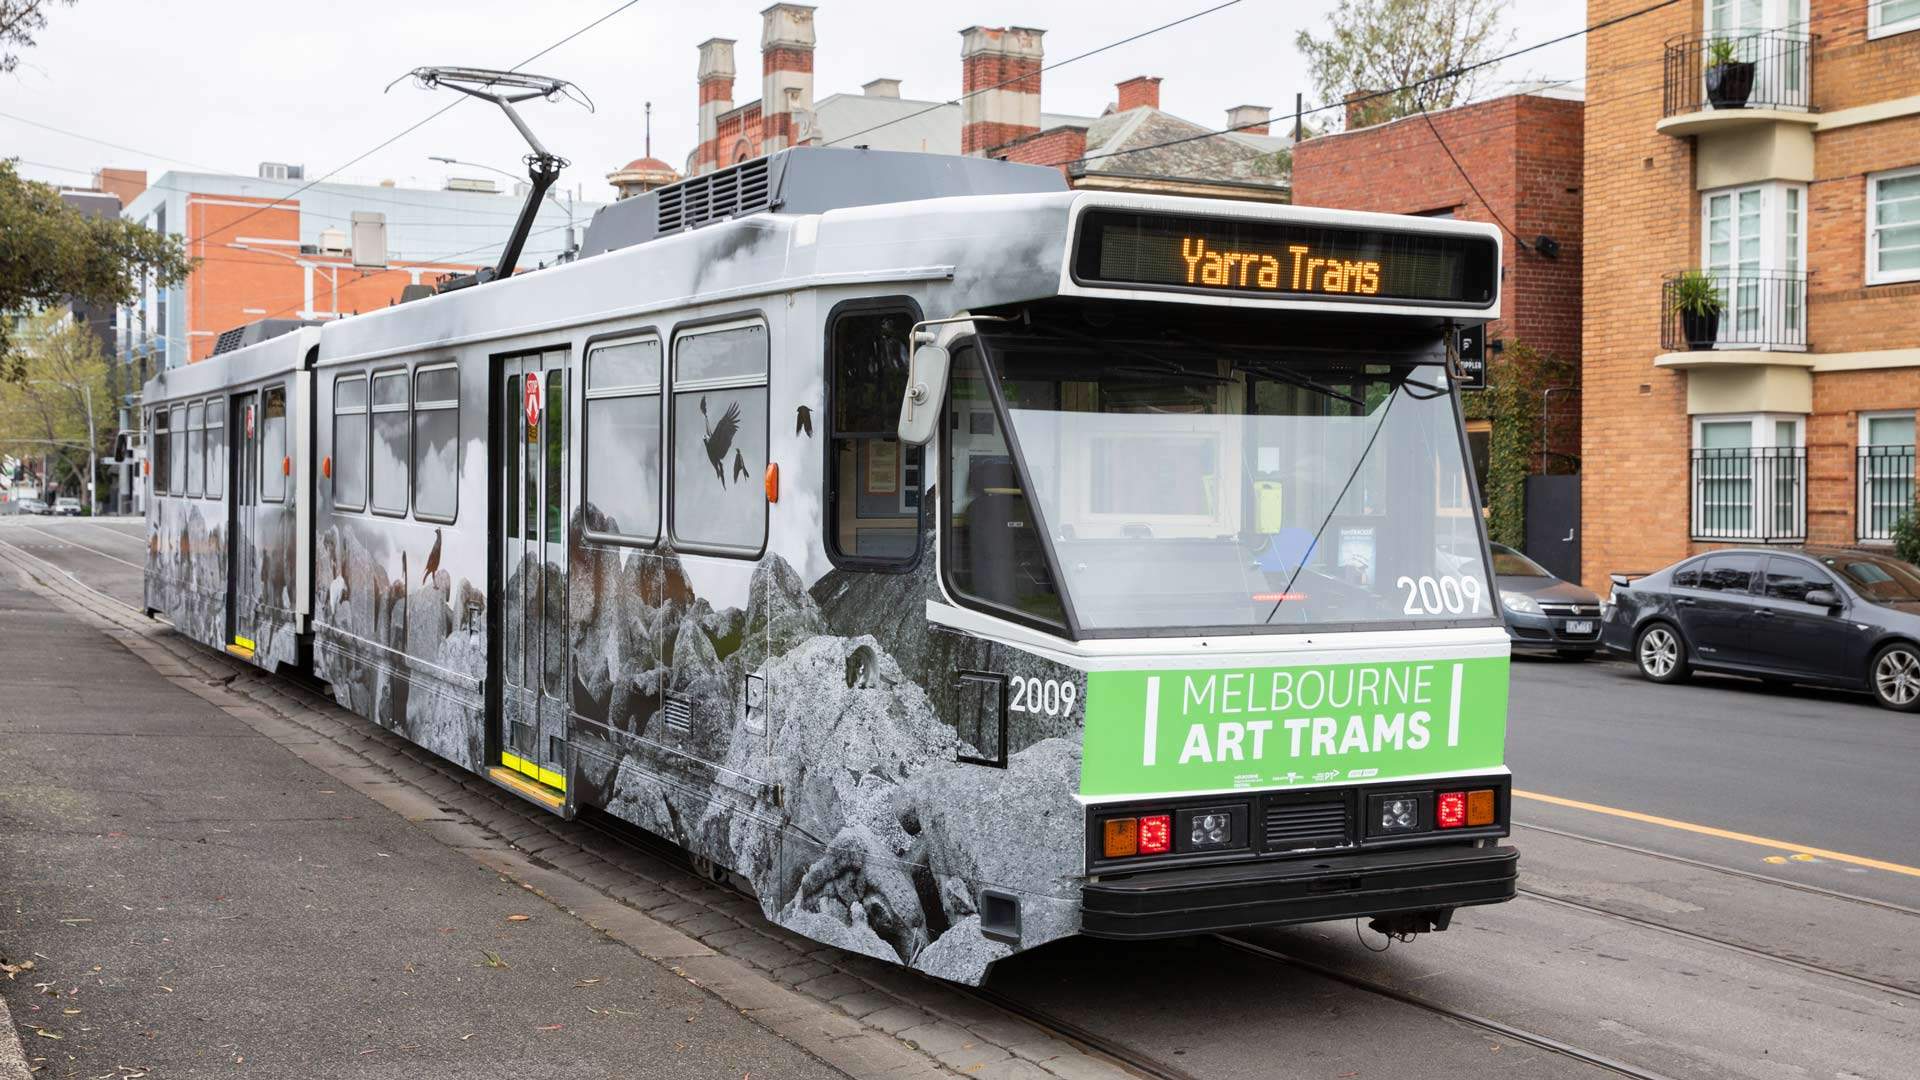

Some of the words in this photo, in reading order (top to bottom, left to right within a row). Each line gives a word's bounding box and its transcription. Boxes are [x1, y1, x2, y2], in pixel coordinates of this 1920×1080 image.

[1182, 237, 1280, 289] Yarra
[1288, 245, 1380, 294] Trams
[527, 380, 538, 393] STOP
[1397, 575, 1482, 615] 2009
[1010, 675, 1076, 717] 2009
[1183, 665, 1434, 715] MELBOURNE
[1178, 719, 1273, 764] ART
[1283, 710, 1431, 758] TRAMS
